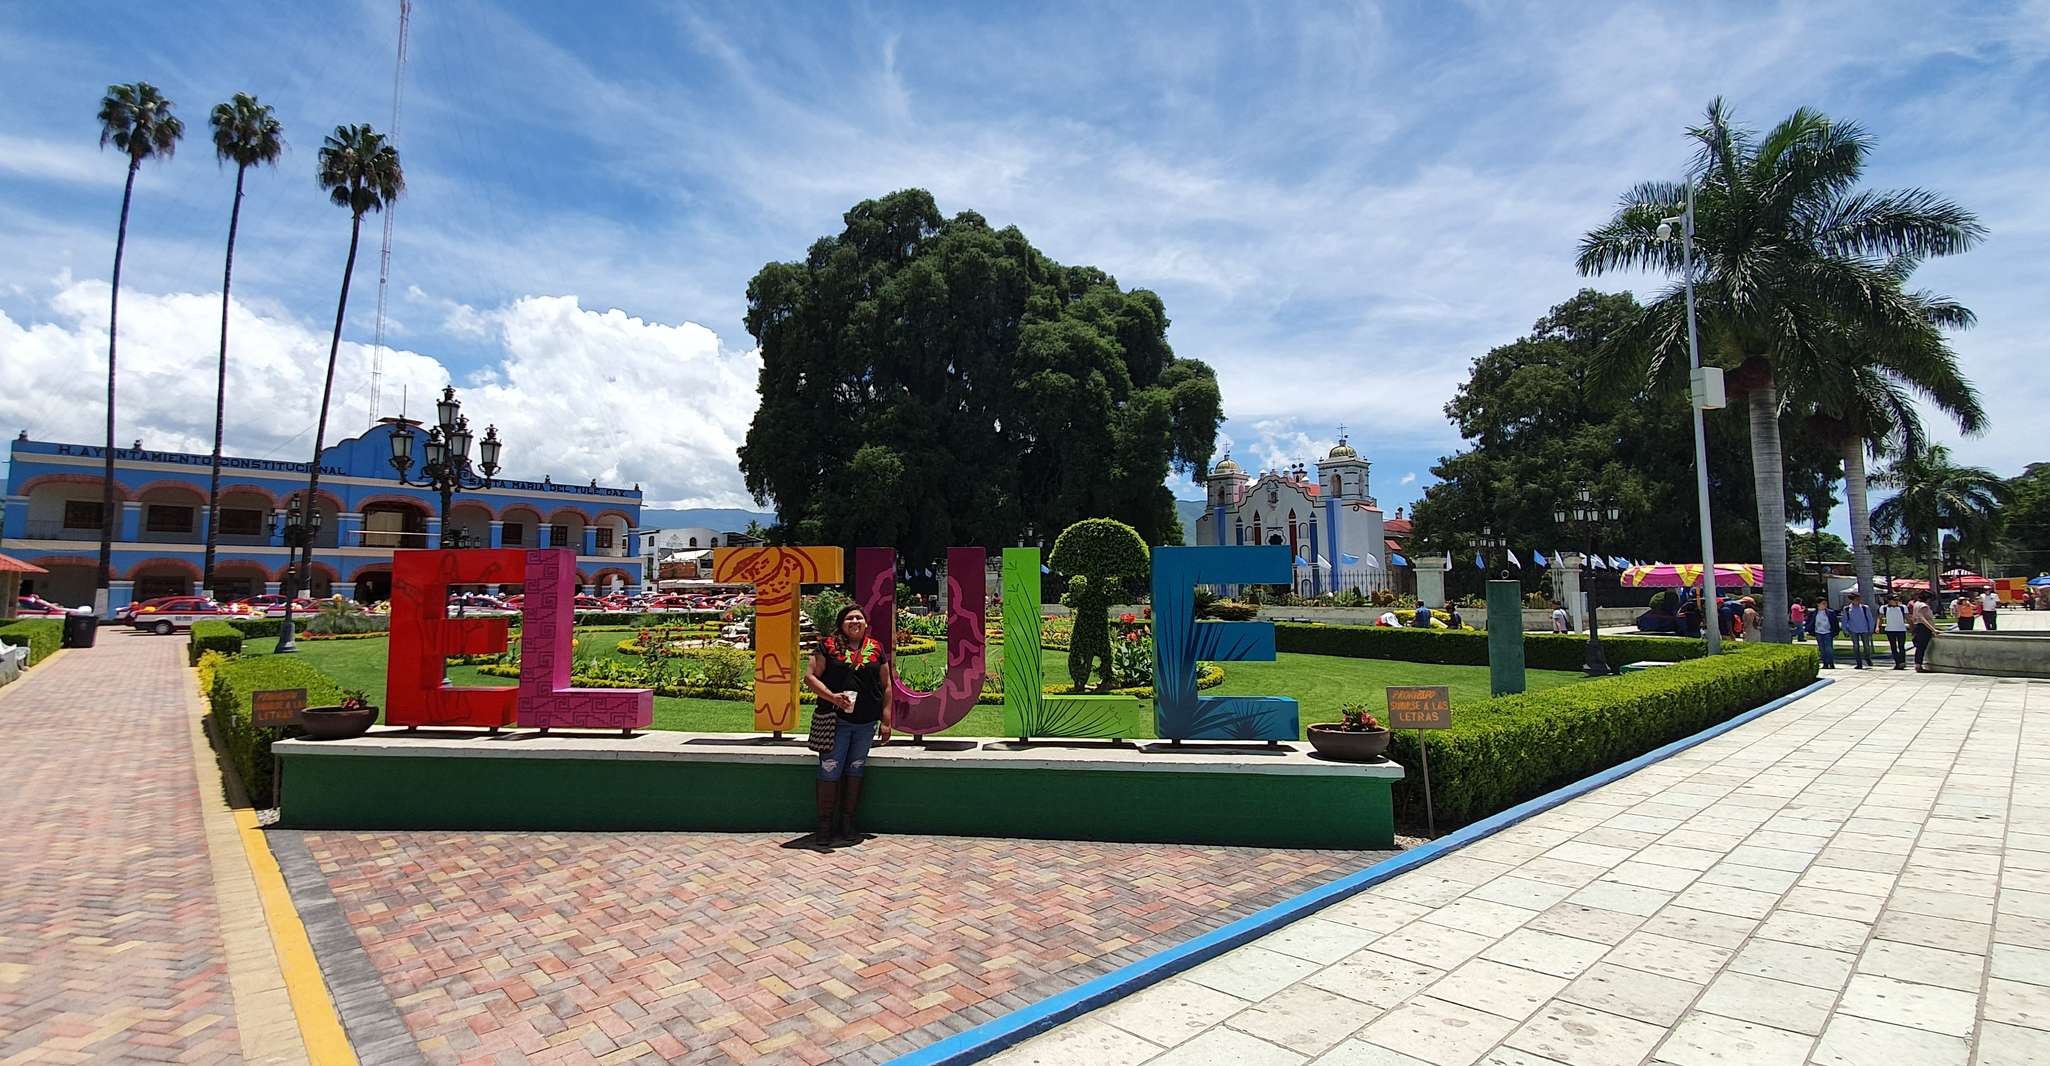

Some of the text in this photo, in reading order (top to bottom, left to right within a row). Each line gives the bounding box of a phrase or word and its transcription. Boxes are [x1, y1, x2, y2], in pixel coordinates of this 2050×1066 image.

[469, 478, 506, 489] SATA
[385, 546, 1299, 740] EL TULE
[1400, 711, 1440, 721] LETRAS
